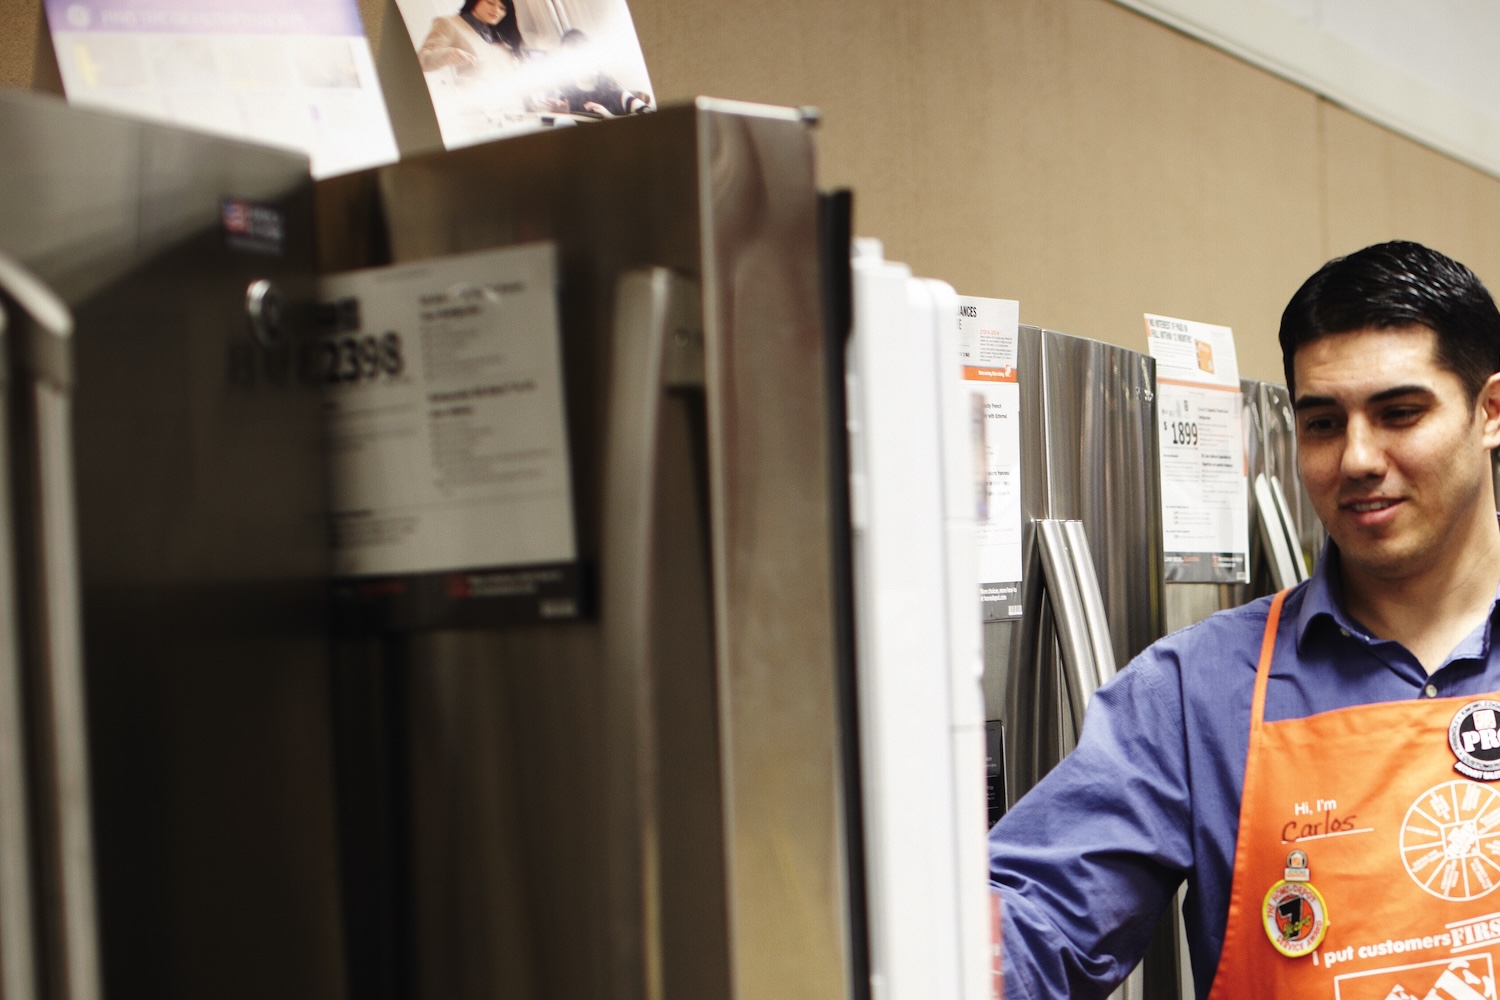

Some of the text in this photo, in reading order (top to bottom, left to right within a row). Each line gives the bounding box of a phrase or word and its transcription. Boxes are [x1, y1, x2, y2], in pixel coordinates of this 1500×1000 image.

[1316, 799, 1337, 812] I'm
[1281, 810, 1357, 843] Carlos
[1324, 947, 1354, 968] put
[1358, 933, 1451, 959] customers
